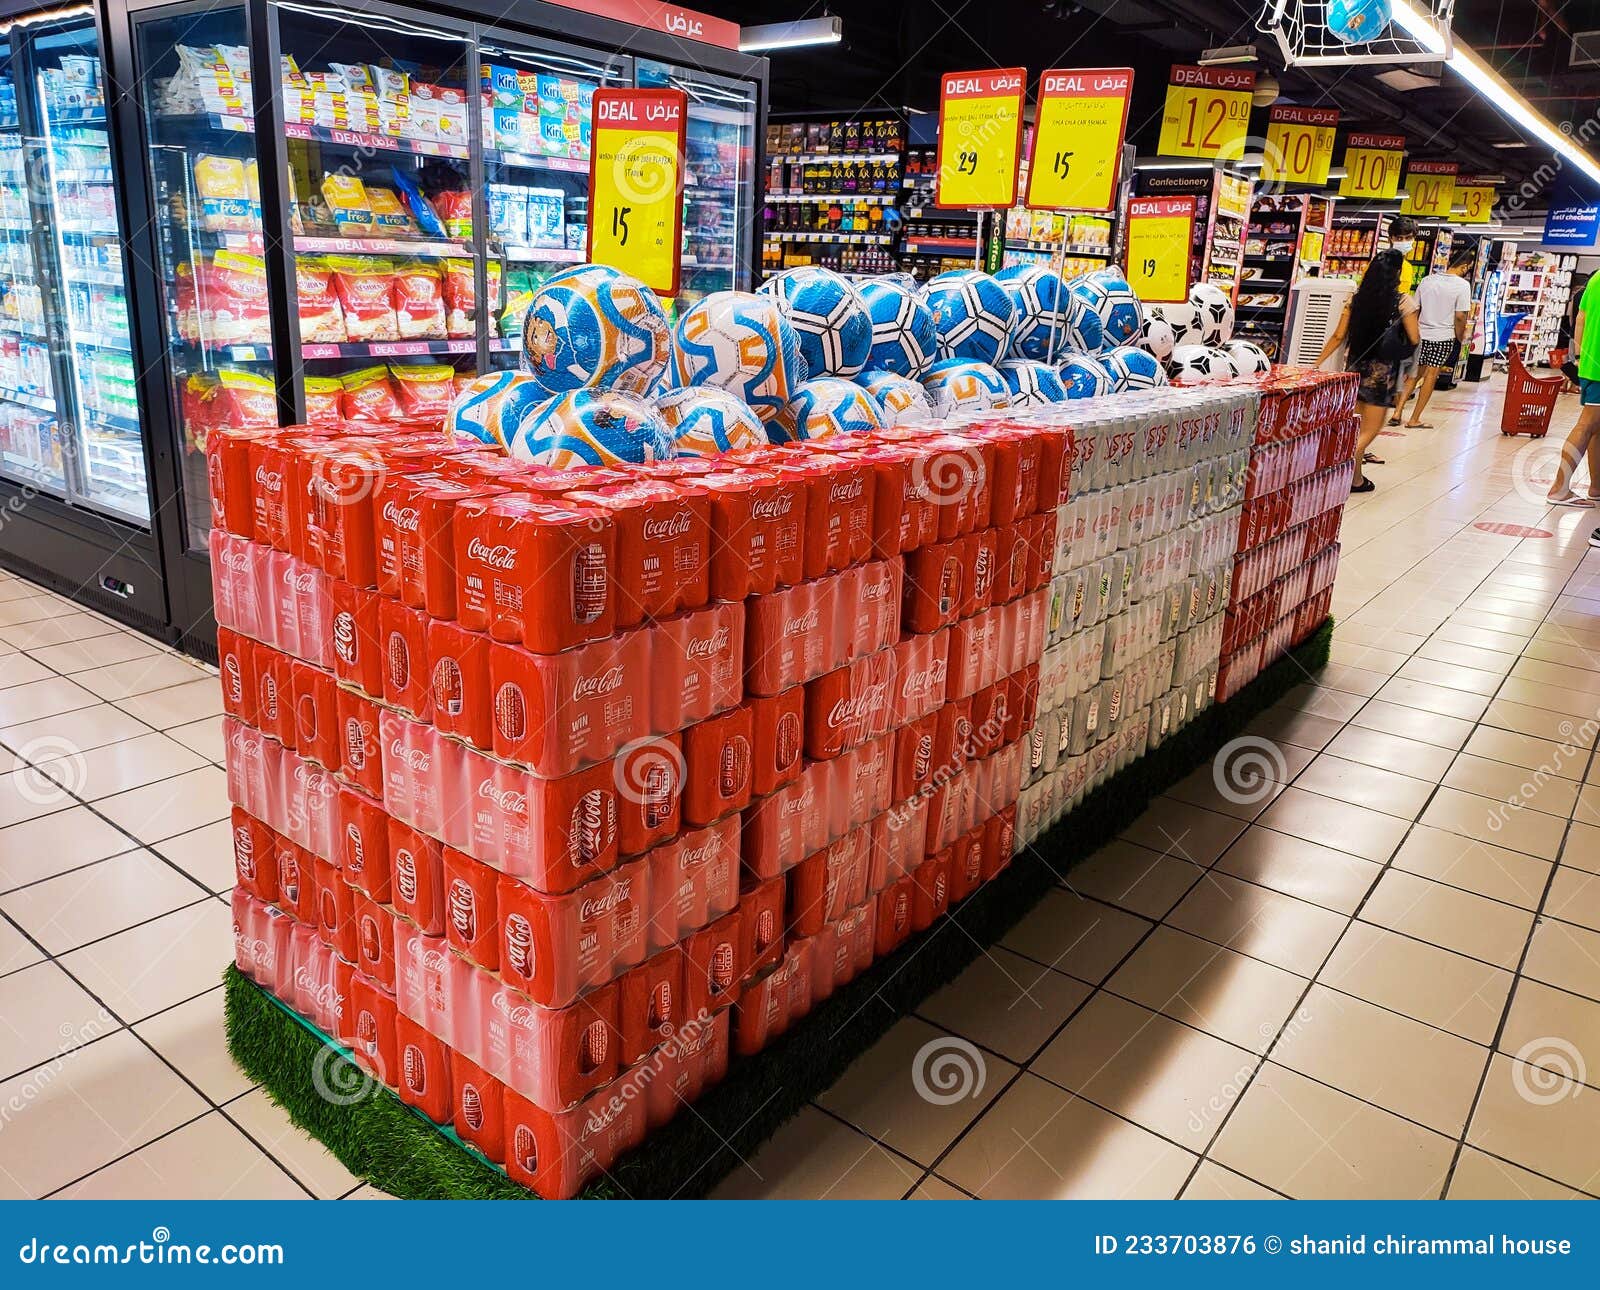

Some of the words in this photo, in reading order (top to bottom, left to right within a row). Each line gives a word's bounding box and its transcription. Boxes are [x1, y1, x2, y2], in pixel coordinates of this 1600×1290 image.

[666, 12, 703, 36] عرض
[498, 74, 516, 89] Kiri
[946, 80, 983, 94] DEAL
[991, 78, 1021, 91] عرض
[1045, 78, 1085, 92] DEAL
[1094, 77, 1127, 91] عرض
[1176, 70, 1212, 85] DEAL
[1217, 72, 1251, 87] عرض
[543, 83, 561, 98] Kiri
[599, 101, 637, 121] DEAL
[647, 101, 679, 120] عرض
[1274, 109, 1304, 121] DEAL
[1308, 111, 1334, 123] عرض
[500, 117, 518, 132] Kiri
[1181, 97, 1227, 149] 12
[546, 124, 562, 138] Kiri
[335, 132, 368, 146] DEAL
[1351, 136, 1376, 146] DEAL
[1379, 138, 1401, 147] عرض
[1276, 132, 1312, 174] 10
[958, 151, 977, 175] 29
[1054, 152, 1074, 179] 15
[1410, 164, 1432, 172] DEAL
[1355, 155, 1385, 190] 10
[1149, 177, 1209, 188] Confectionery
[1413, 180, 1440, 211] 04
[1131, 204, 1161, 214] DEAL
[1167, 202, 1192, 213] عرض
[613, 206, 631, 246] 15
[336, 240, 366, 251] DEAL
[990, 227, 1000, 270] Coffee
[1143, 259, 1156, 277] 19
[375, 345, 395, 355] DEAL
[751, 535, 764, 547] WIN
[643, 557, 659, 571] WIN
[467, 576, 482, 590] WIN
[684, 672, 698, 687] WIN
[572, 715, 588, 732] WIN
[579, 934, 598, 952] WIN
